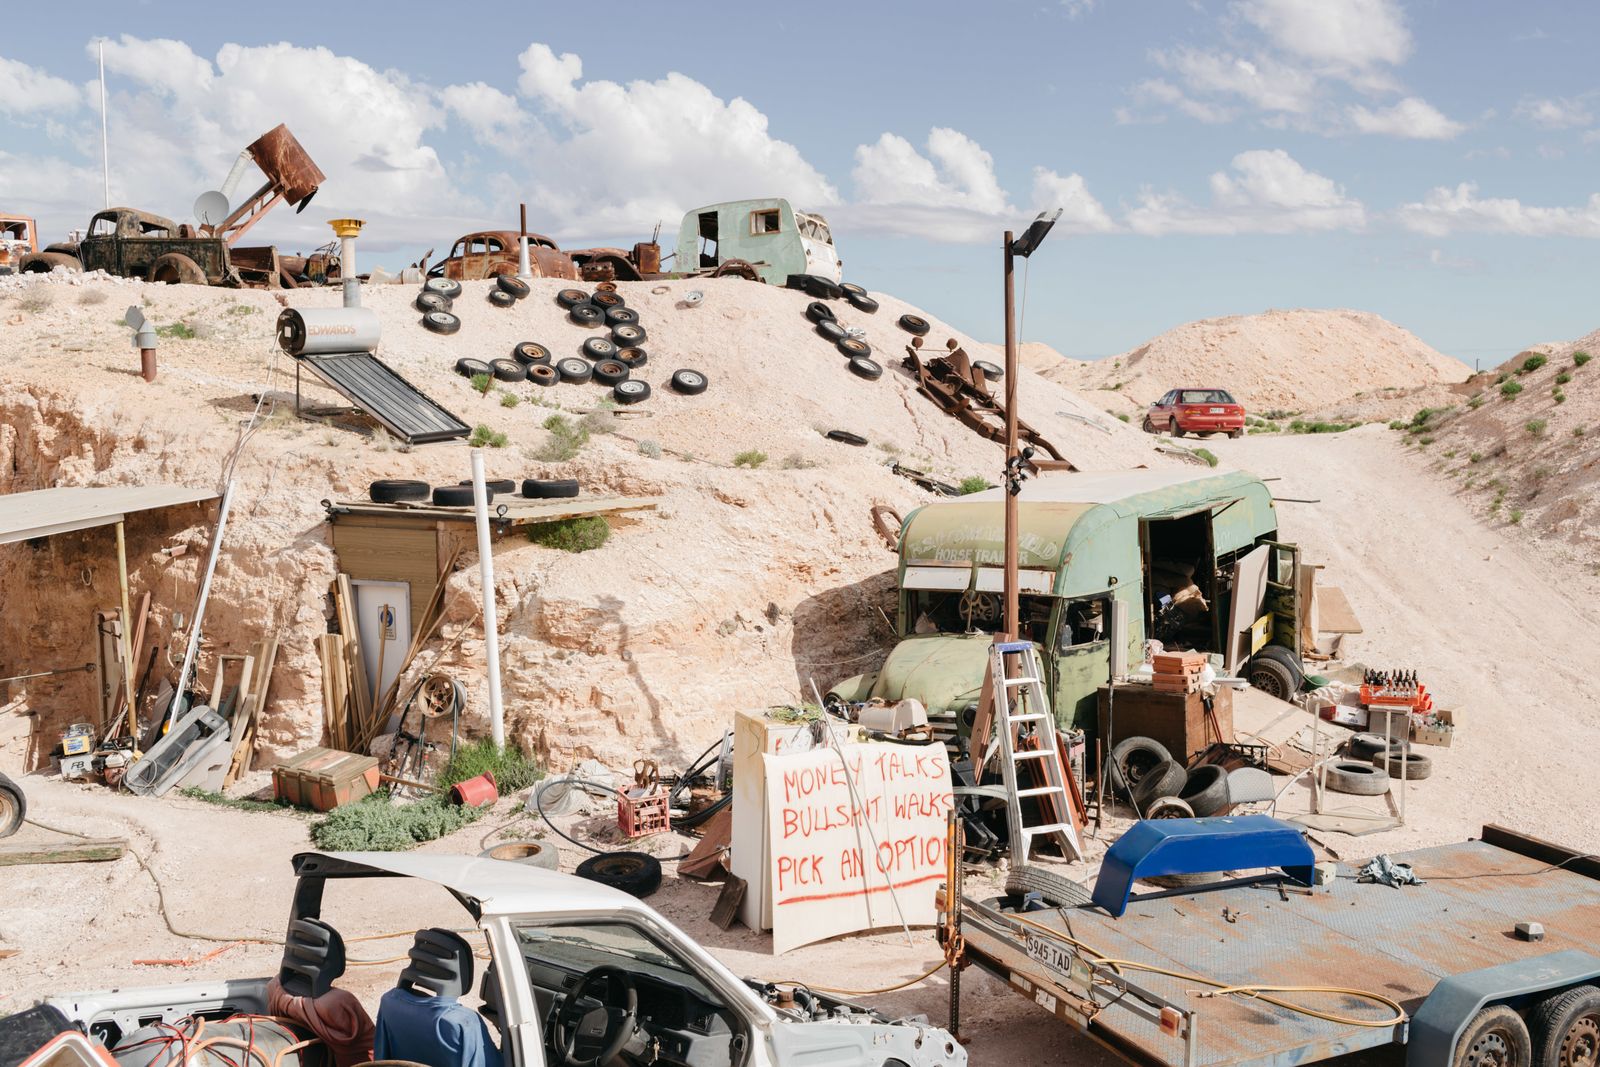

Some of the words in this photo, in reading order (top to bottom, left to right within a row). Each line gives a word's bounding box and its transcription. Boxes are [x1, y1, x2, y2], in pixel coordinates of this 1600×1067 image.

[307, 324, 357, 336] EDWARDS
[934, 547, 973, 562] HORSE
[974, 548, 1029, 564] TRAIR
[784, 757, 862, 803] MONEY
[875, 751, 945, 781] TALKS
[782, 795, 882, 839] BULLSHIT
[894, 792, 955, 822] WALKS
[777, 854, 824, 891] PICK
[841, 848, 865, 880] AN
